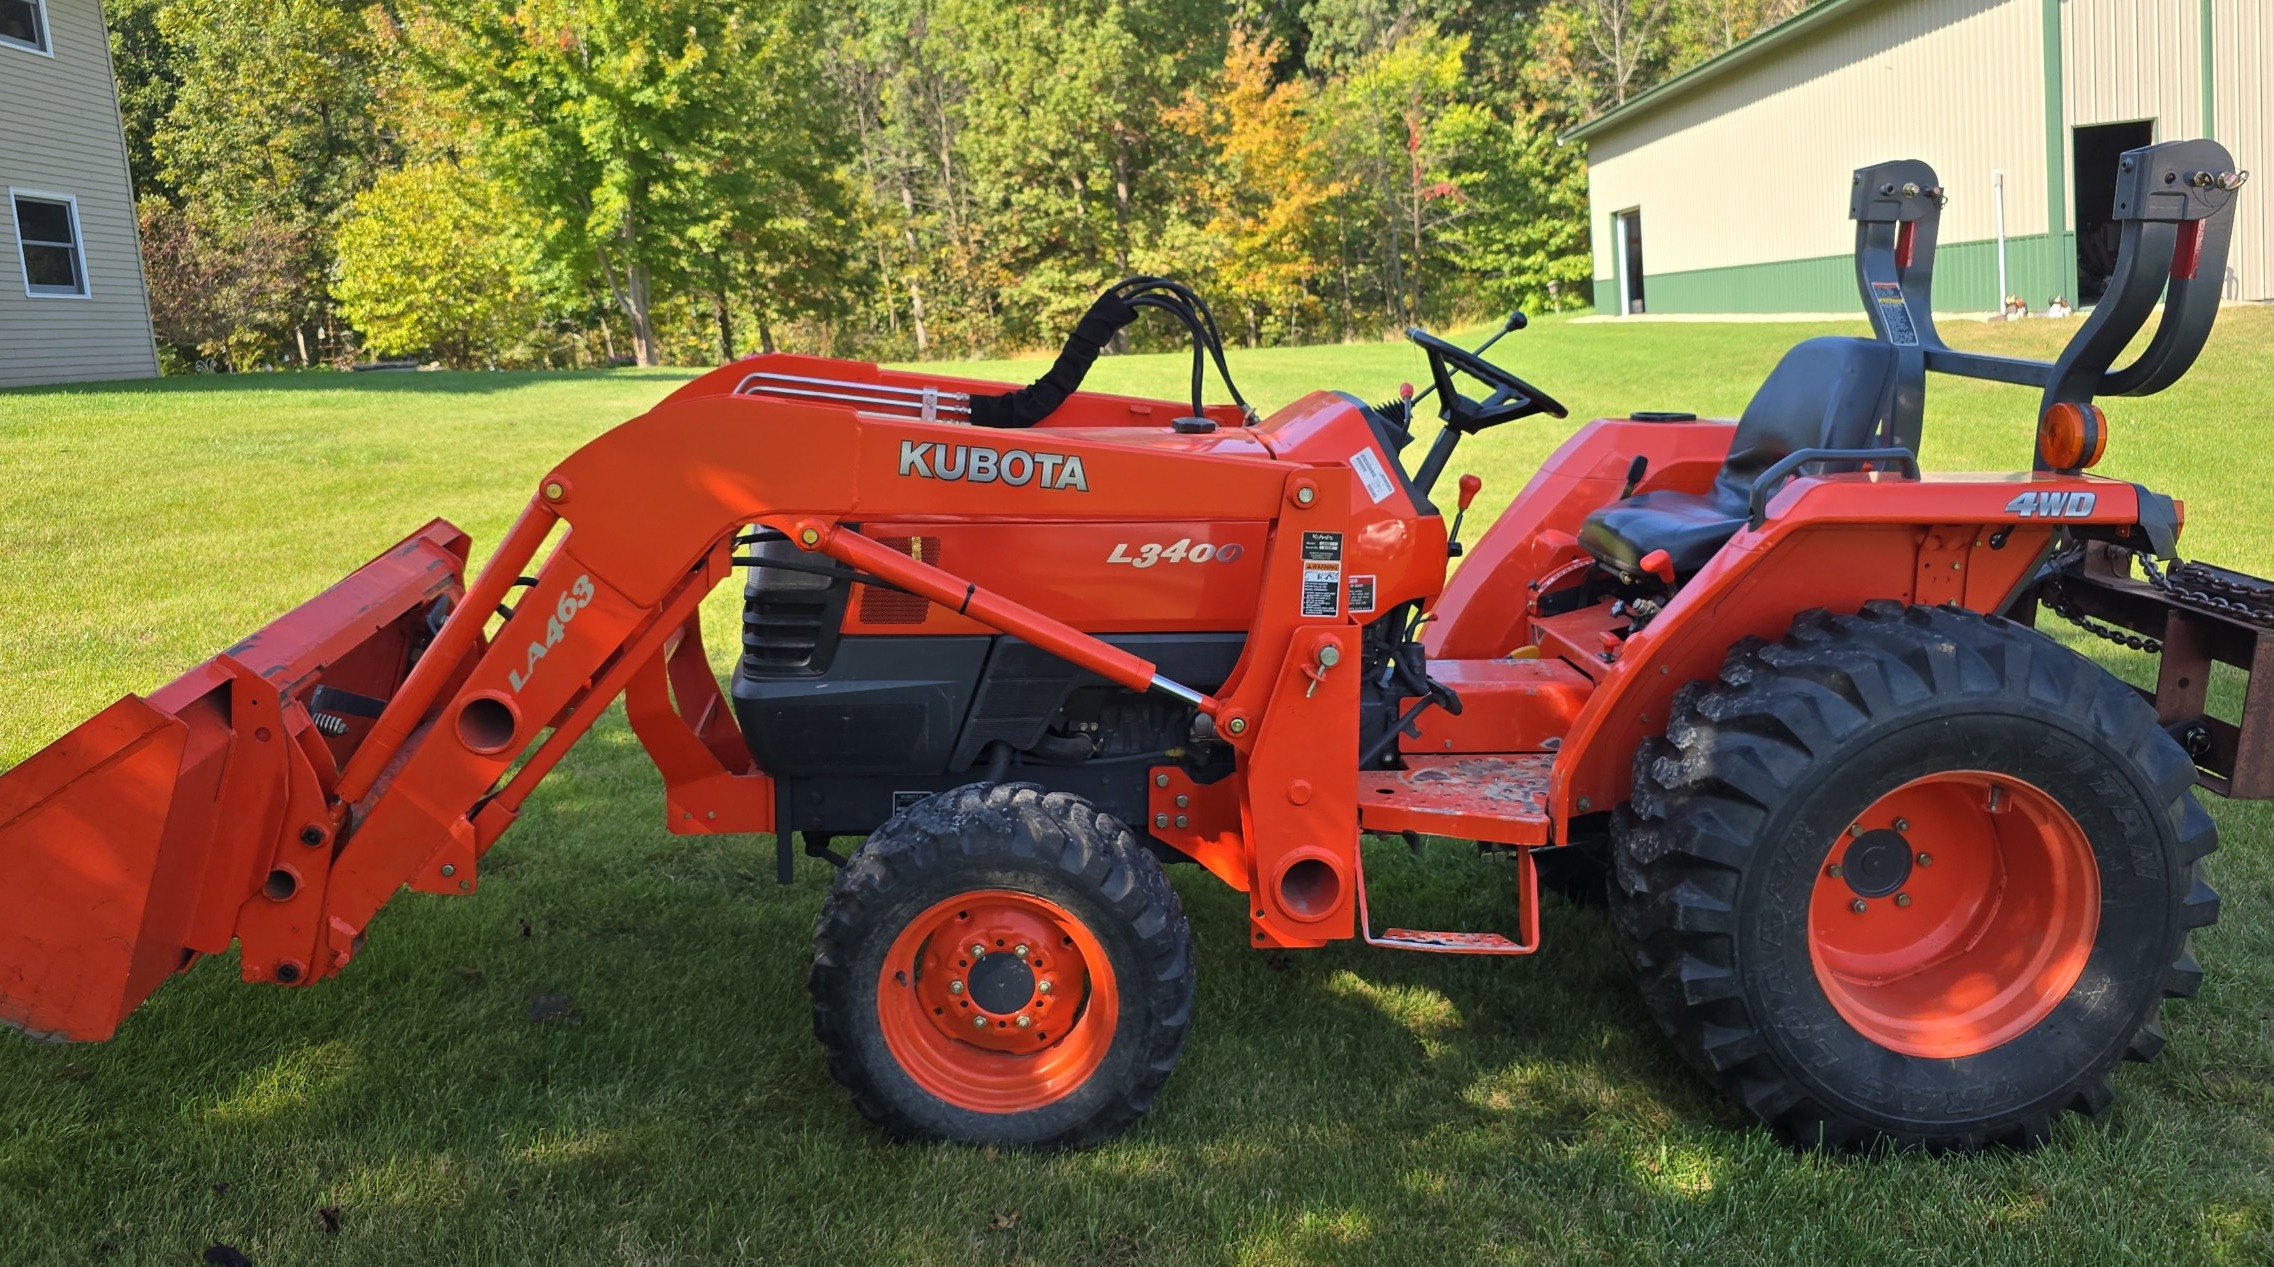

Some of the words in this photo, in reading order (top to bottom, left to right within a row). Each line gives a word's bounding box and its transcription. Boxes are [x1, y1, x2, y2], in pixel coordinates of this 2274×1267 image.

[898, 440, 1089, 492] KUBOTA
[2004, 491, 2097, 518] 4WD
[1106, 538, 1244, 568] L3400
[508, 574, 595, 694] LA463
